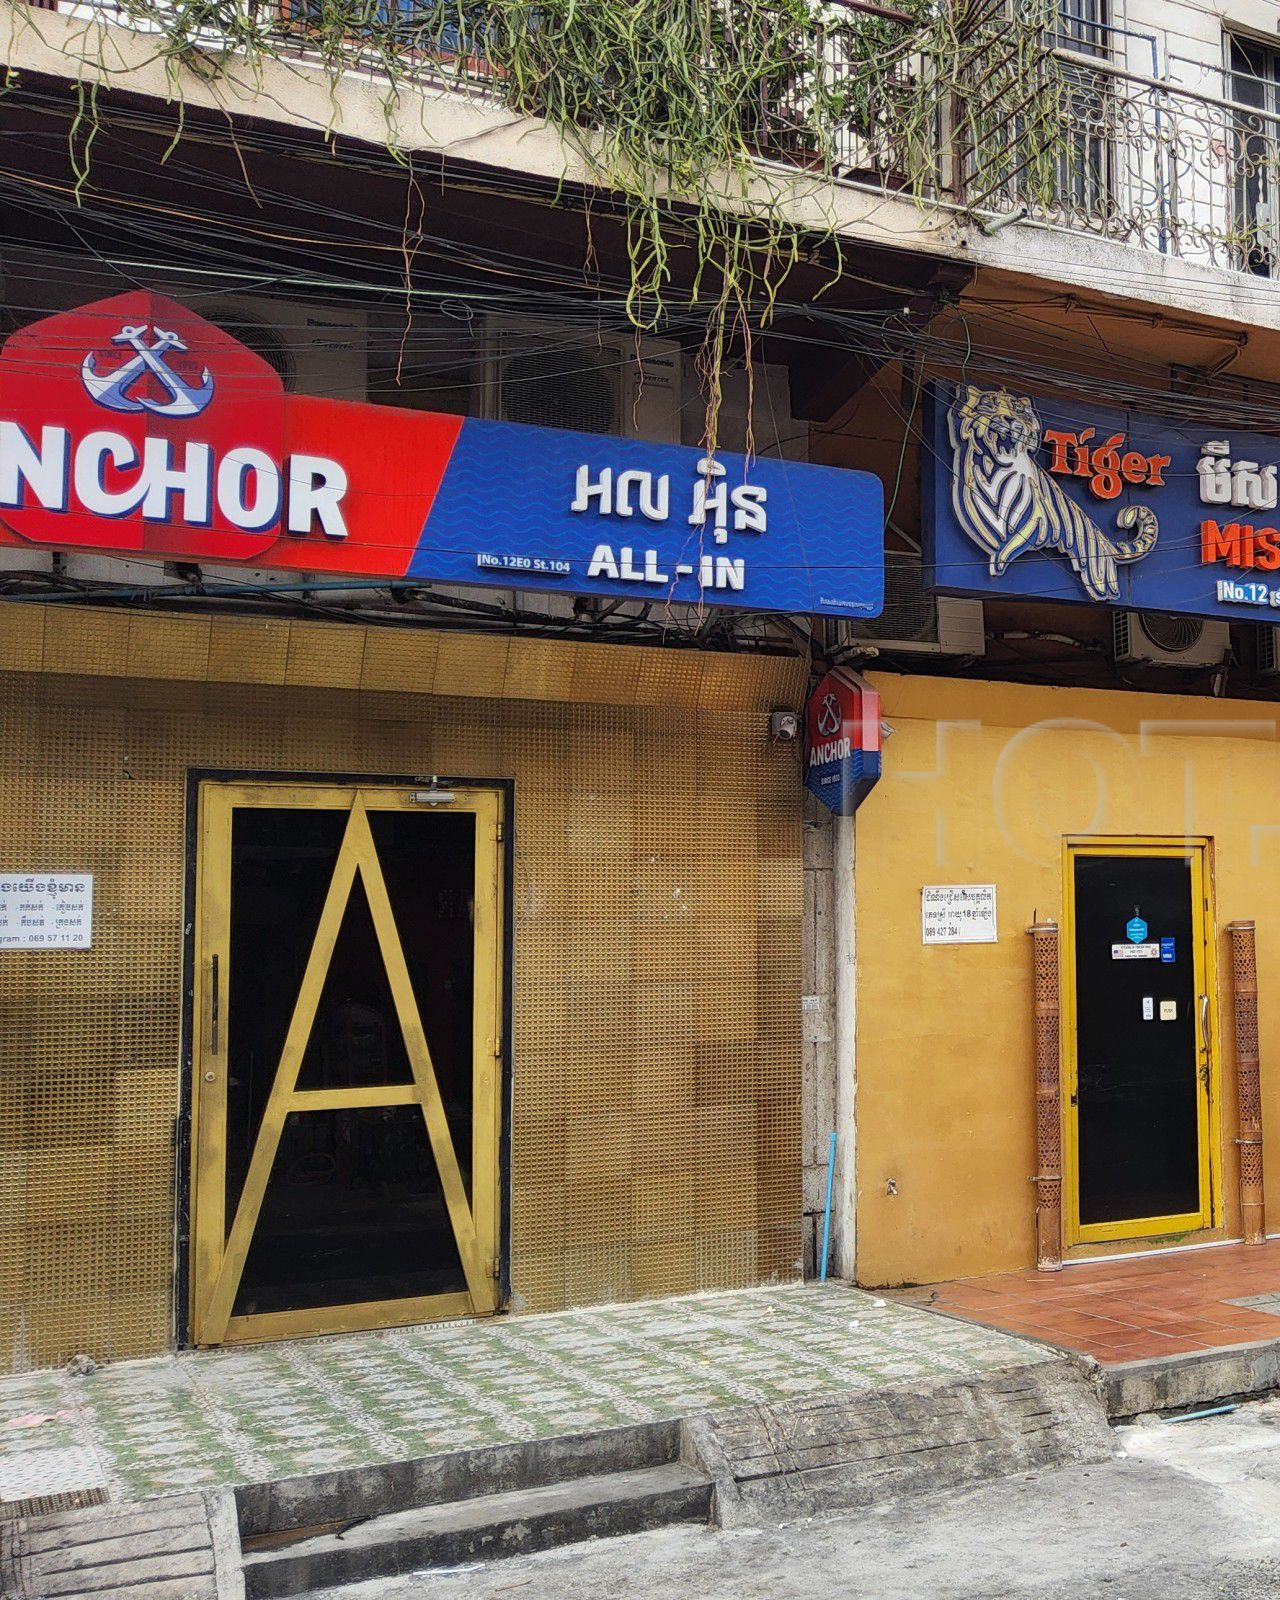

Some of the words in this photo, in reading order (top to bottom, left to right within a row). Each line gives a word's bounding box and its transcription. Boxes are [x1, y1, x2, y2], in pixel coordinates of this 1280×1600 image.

[1043, 427, 1172, 499] Tiger
[809, 737, 851, 768] ANCHOR
[29, 934, 45, 942] 069
[48, 934, 58, 942] 57
[61, 934, 70, 942] 11
[73, 934, 84, 942] 20
